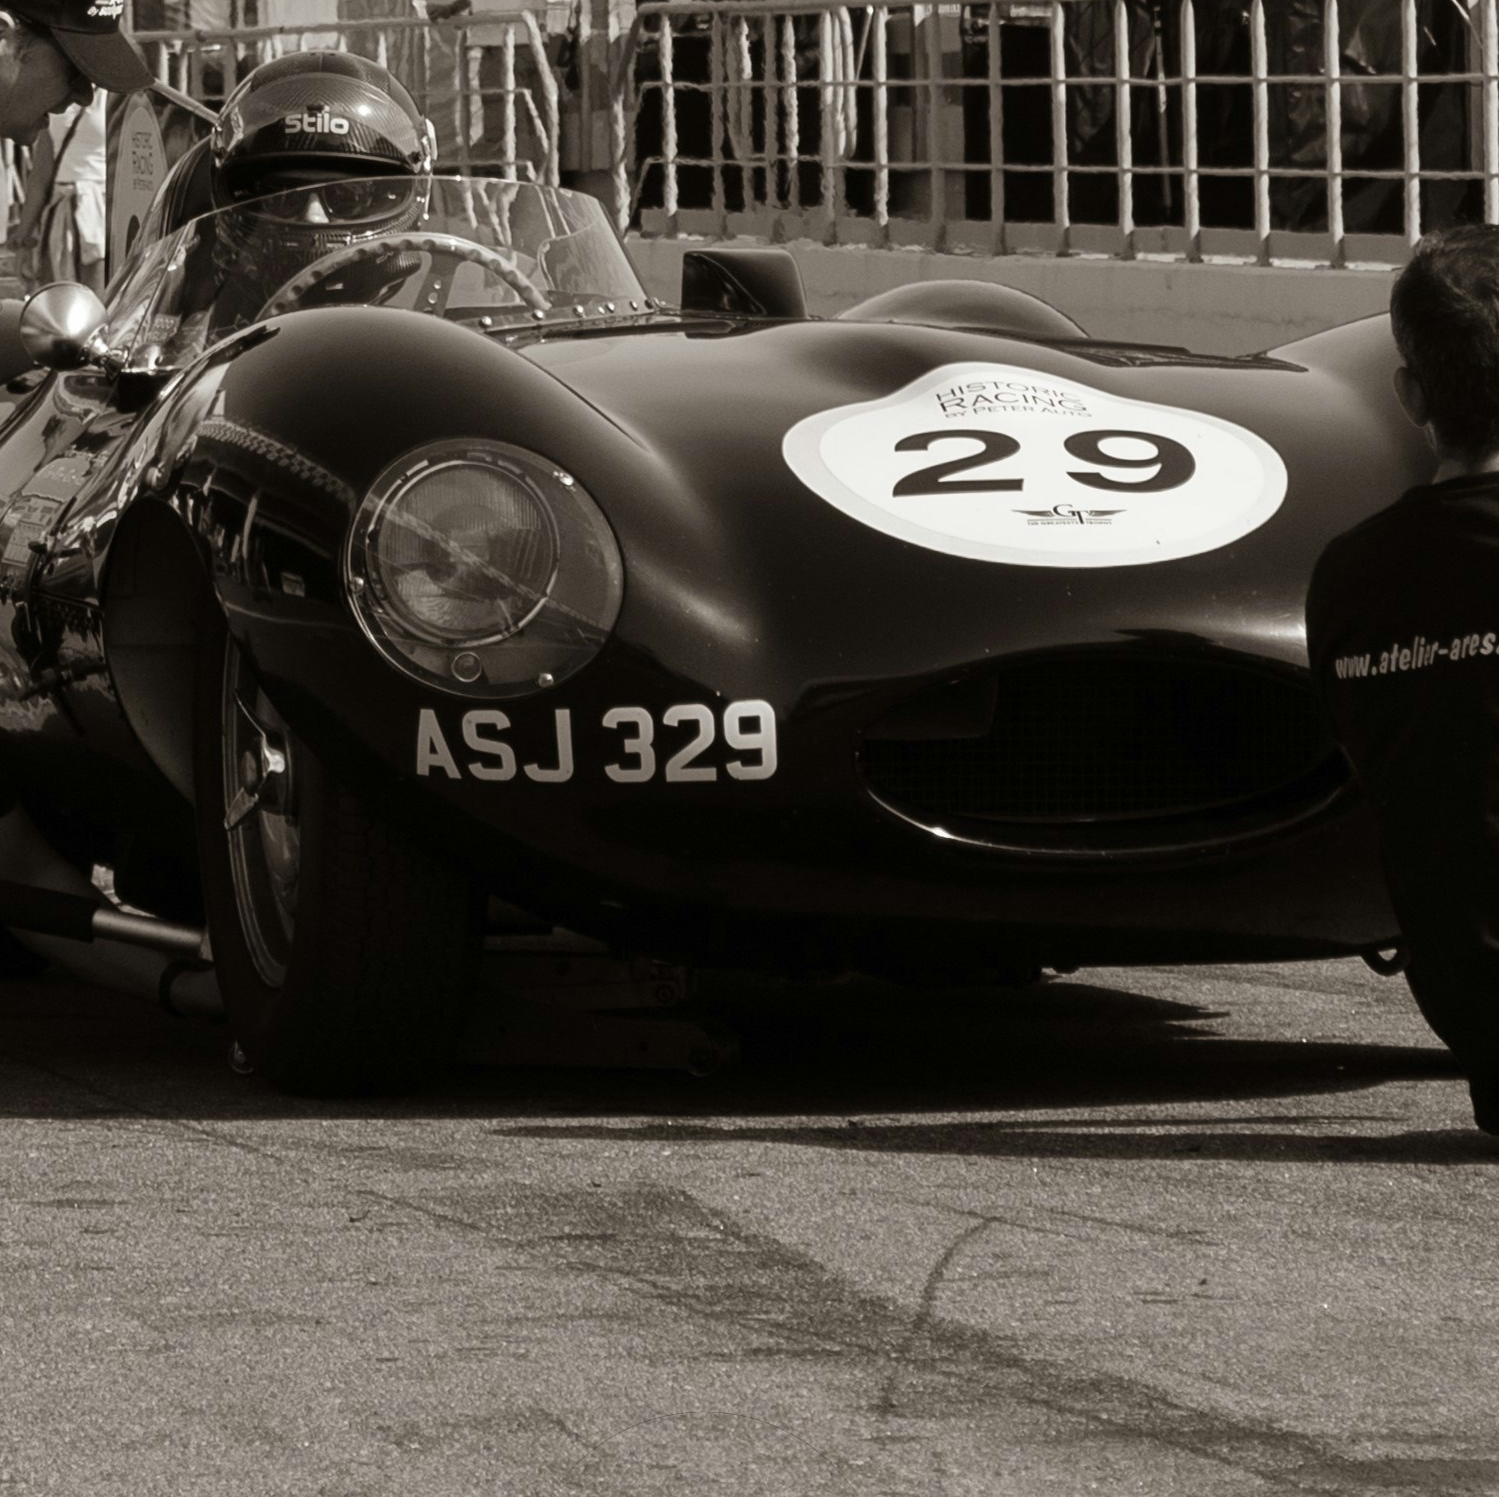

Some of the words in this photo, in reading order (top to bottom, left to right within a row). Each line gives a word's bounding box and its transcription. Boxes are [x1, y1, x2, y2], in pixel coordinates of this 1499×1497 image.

[935, 381, 1082, 404] HISTORIC
[939, 392, 1087, 413] RACING
[945, 410, 967, 418] BY
[973, 406, 1034, 415] PETER
[1041, 407, 1093, 418] AUTO
[892, 429, 1197, 498] 29
[416, 708, 574, 783] ASJ
[602, 699, 778, 783] 329
